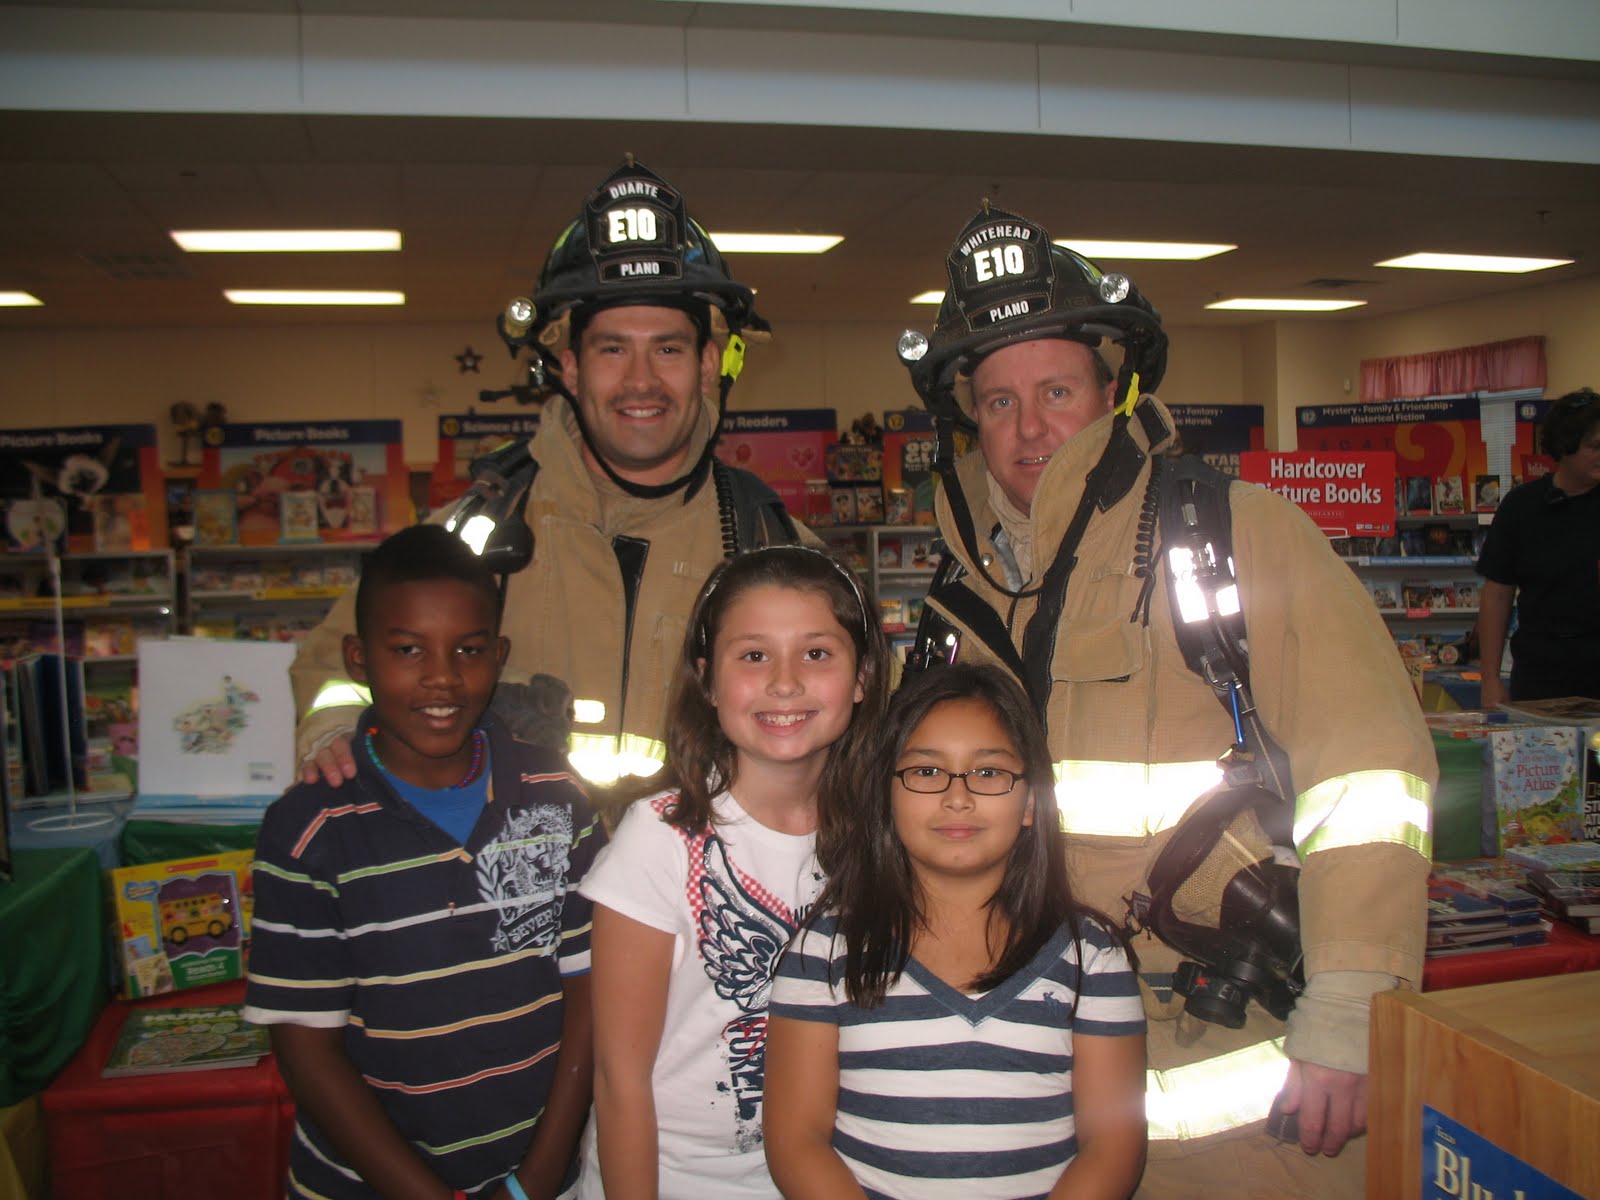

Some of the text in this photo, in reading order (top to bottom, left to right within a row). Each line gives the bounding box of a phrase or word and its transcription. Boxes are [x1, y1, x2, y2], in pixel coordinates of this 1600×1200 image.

[609, 182, 658, 199] DUARTE
[608, 208, 656, 243] E10
[960, 225, 1031, 257] WHITEHEAD
[620, 262, 660, 276] PLANO
[973, 244, 1024, 282] E10
[990, 301, 1030, 323] PLANO
[1186, 408, 1219, 418] Fantasy
[1322, 406, 1357, 417] Mystery
[1363, 404, 1392, 415] Family
[1402, 402, 1449, 413] Friendship
[736, 417, 789, 429] Readers
[1184, 417, 1213, 425] Novels
[1351, 413, 1425, 424] Historical Fiction
[56, 431, 104, 446] Books
[253, 426, 350, 441] Picture Books
[1270, 457, 1366, 479] Hardcover
[1256, 482, 1382, 504] cture Books
[1516, 763, 1561, 778] Picture
[1523, 777, 1557, 792] Atlas
